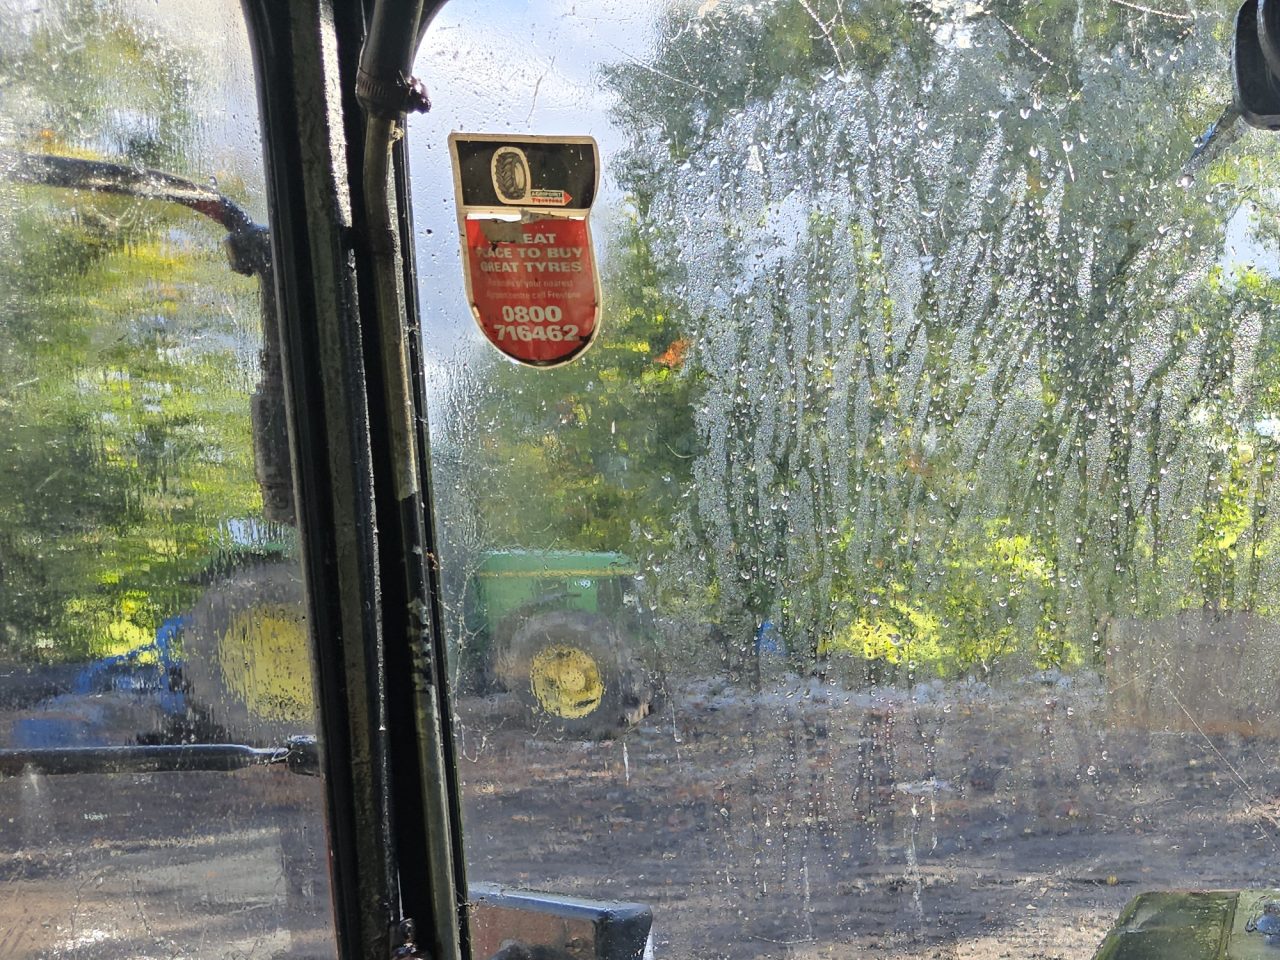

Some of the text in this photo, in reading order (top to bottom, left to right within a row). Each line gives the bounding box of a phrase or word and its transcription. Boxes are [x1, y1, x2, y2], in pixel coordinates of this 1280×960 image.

[517, 247, 541, 258] TO
[547, 247, 583, 259] BUY
[480, 260, 583, 273] GREAT TYRES
[502, 305, 562, 323] 0800
[495, 324, 579, 342] 716462
